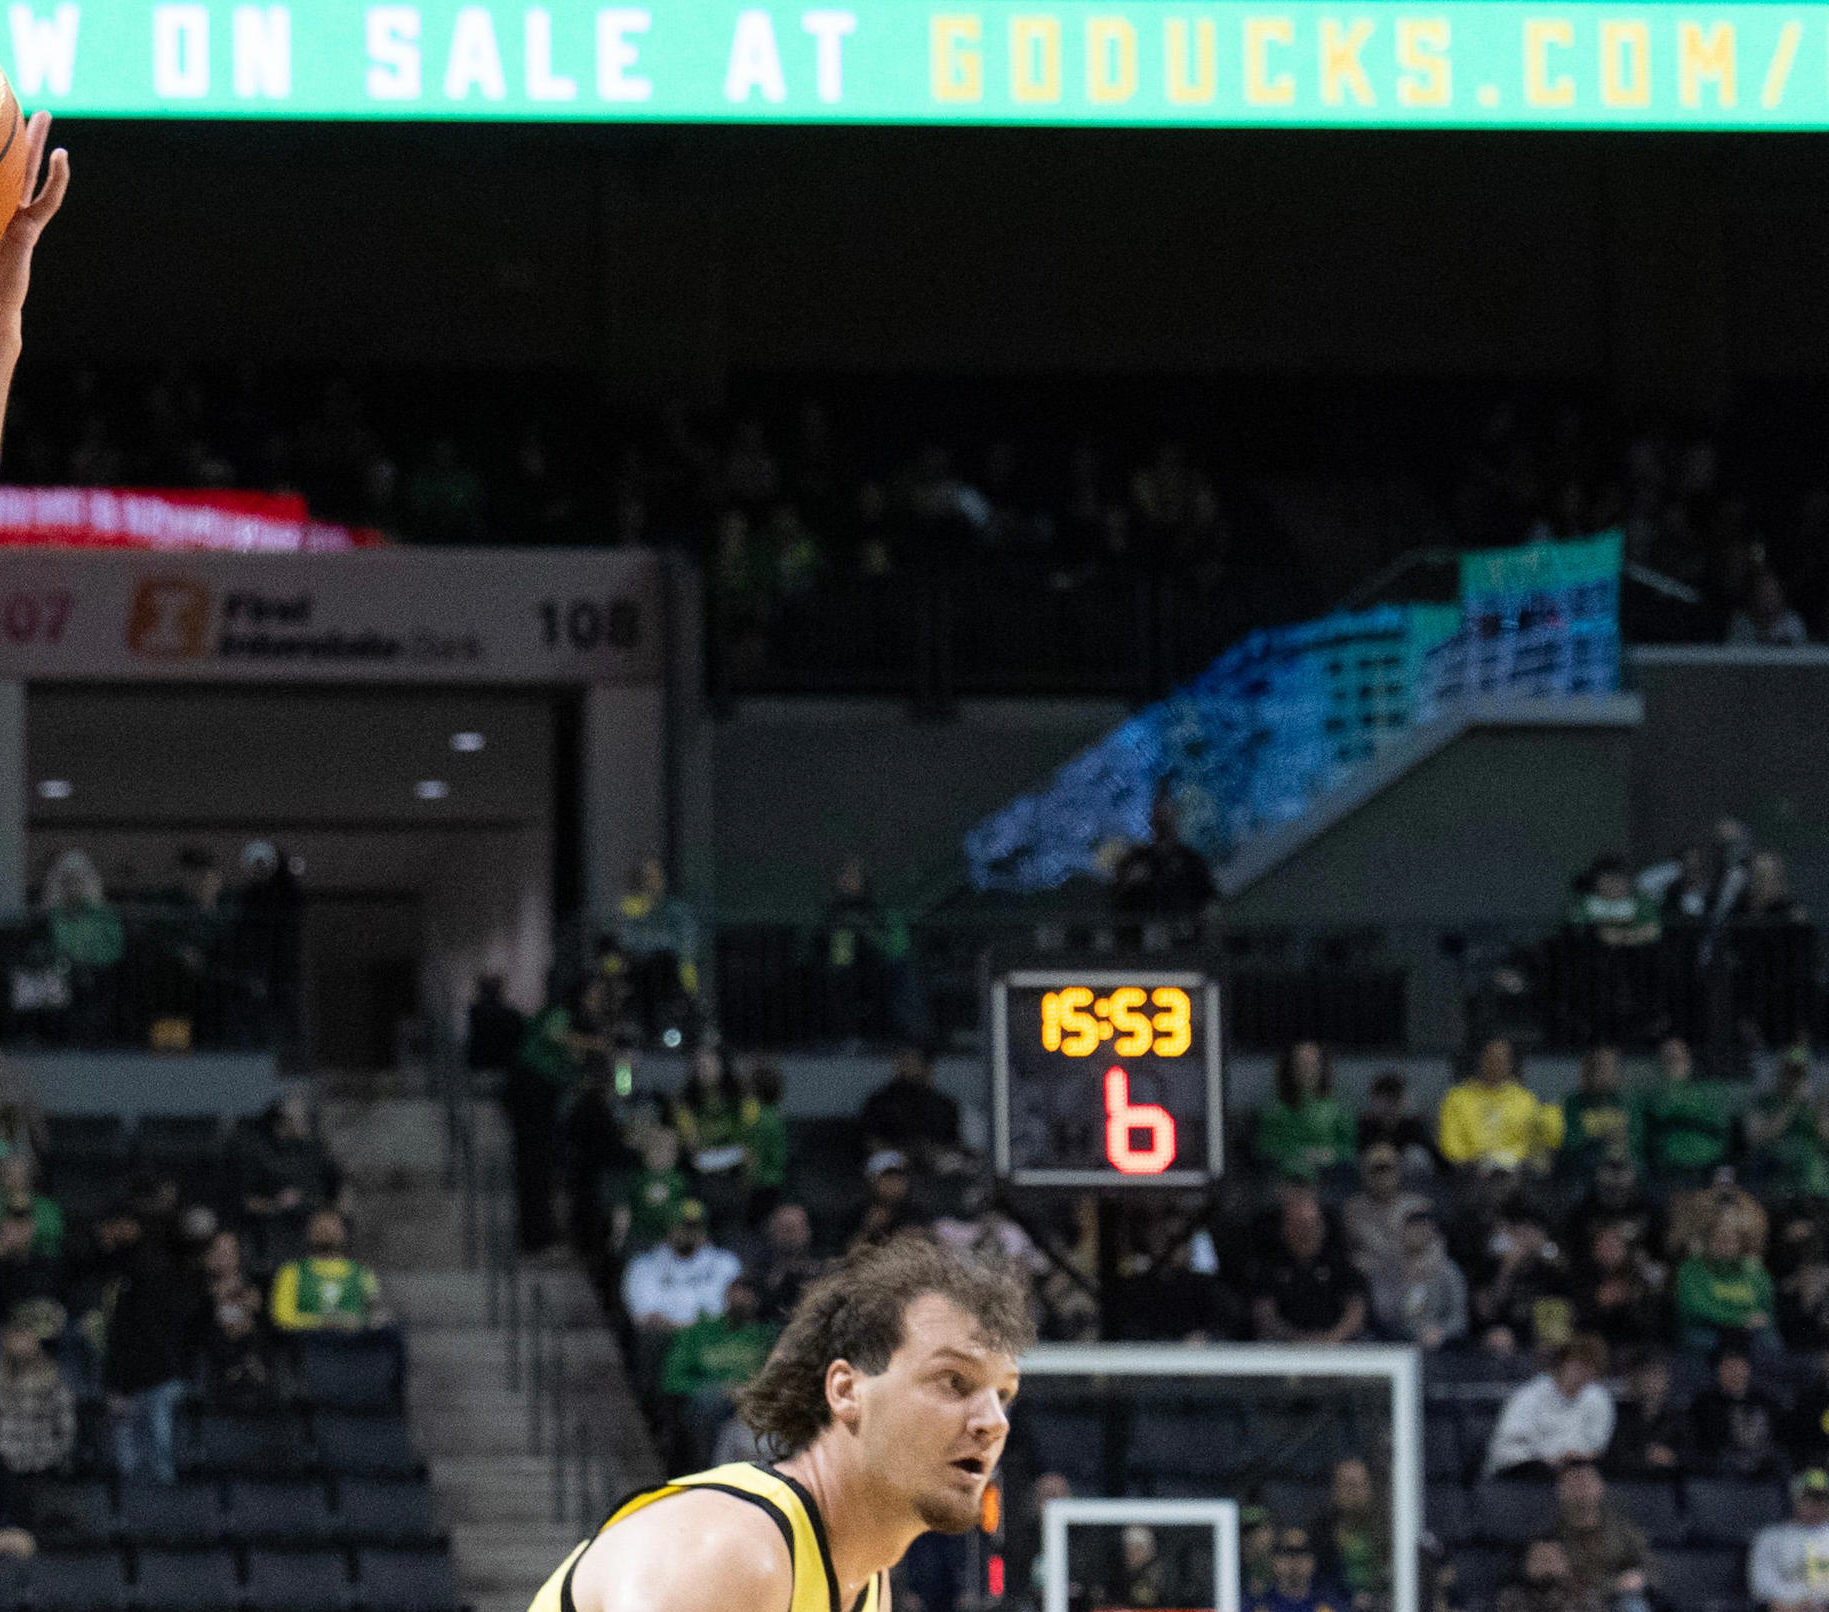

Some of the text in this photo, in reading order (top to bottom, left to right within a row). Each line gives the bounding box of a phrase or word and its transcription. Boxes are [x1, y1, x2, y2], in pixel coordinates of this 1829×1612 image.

[153, 5, 292, 99] ON
[366, 6, 653, 101] SALE
[722, 9, 858, 103] AT
[1041, 986, 1192, 1057] 15:53
[1103, 1066, 1176, 1175] 6
